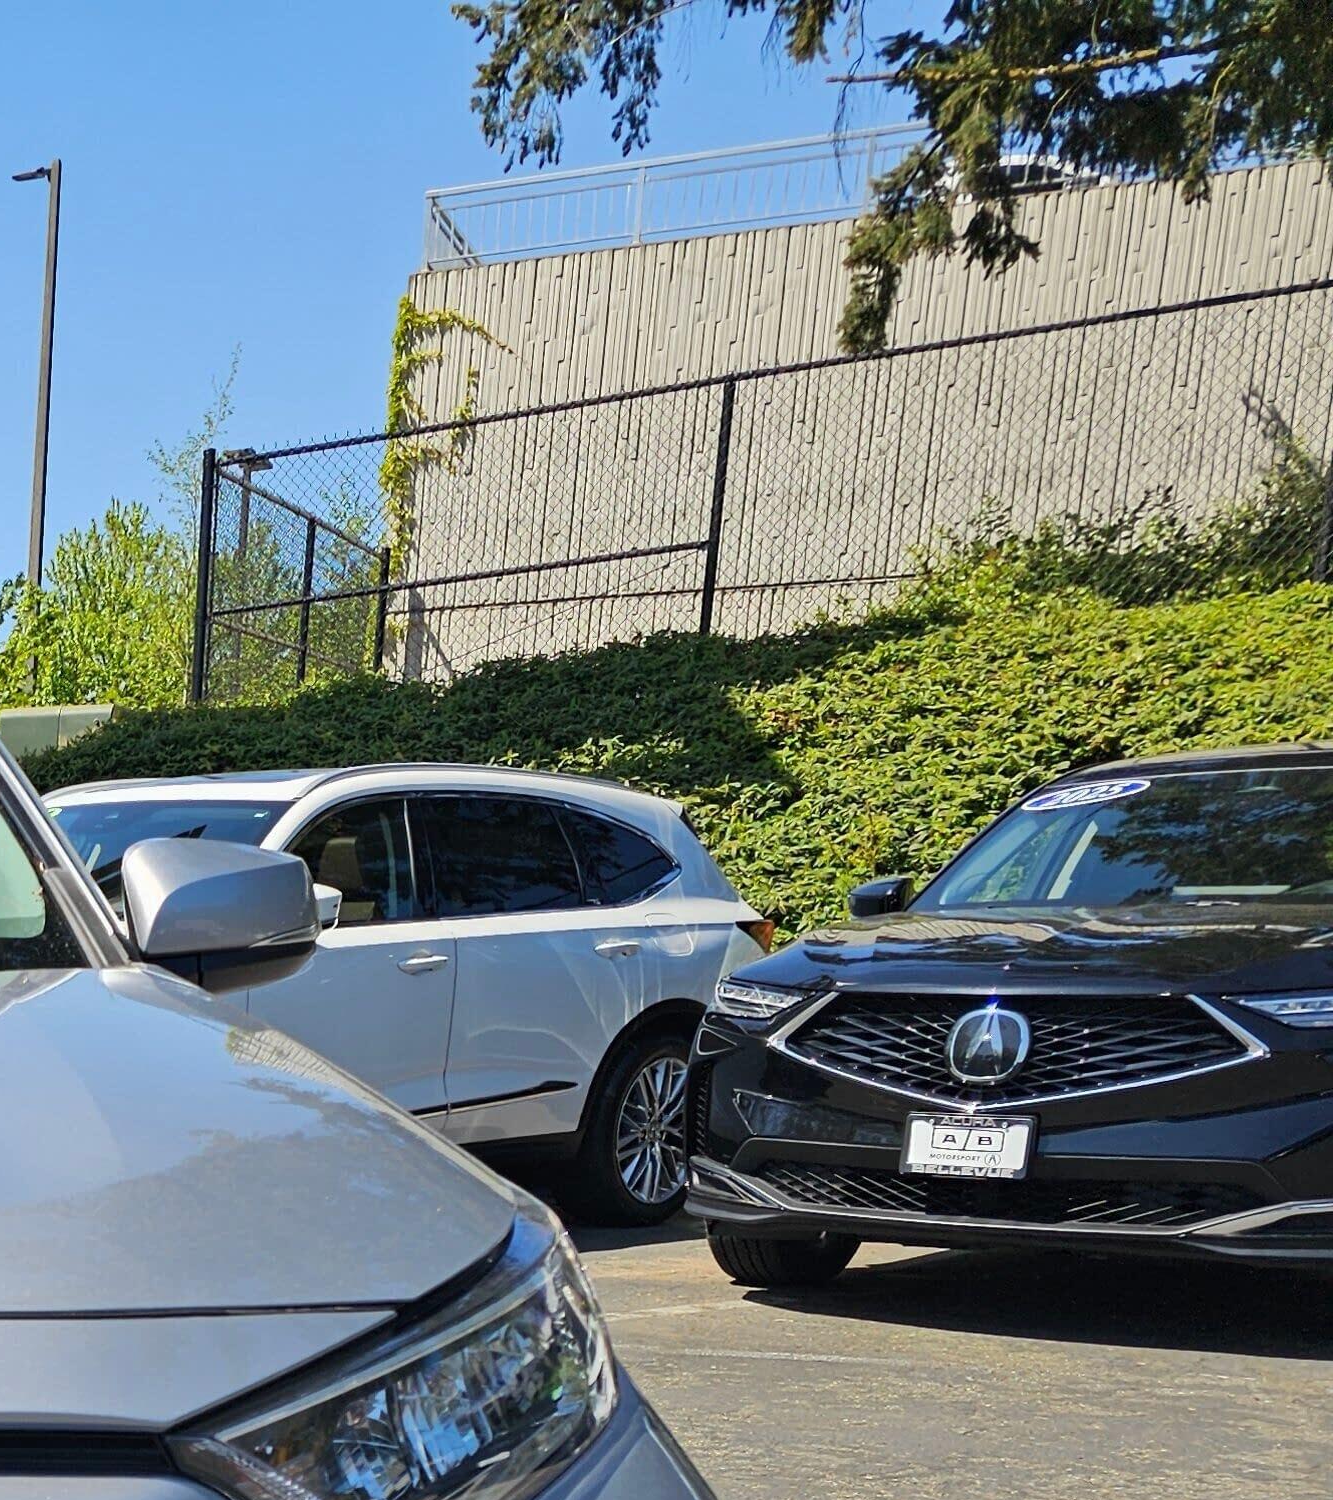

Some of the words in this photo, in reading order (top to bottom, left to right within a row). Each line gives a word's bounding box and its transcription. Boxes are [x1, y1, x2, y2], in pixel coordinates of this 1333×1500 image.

[1038, 783, 1130, 807] 2025
[940, 1116, 996, 1127] ACURA
[928, 1153, 981, 1161] MOTORSPORT
[911, 1163, 1015, 1178] BELLEVUE
